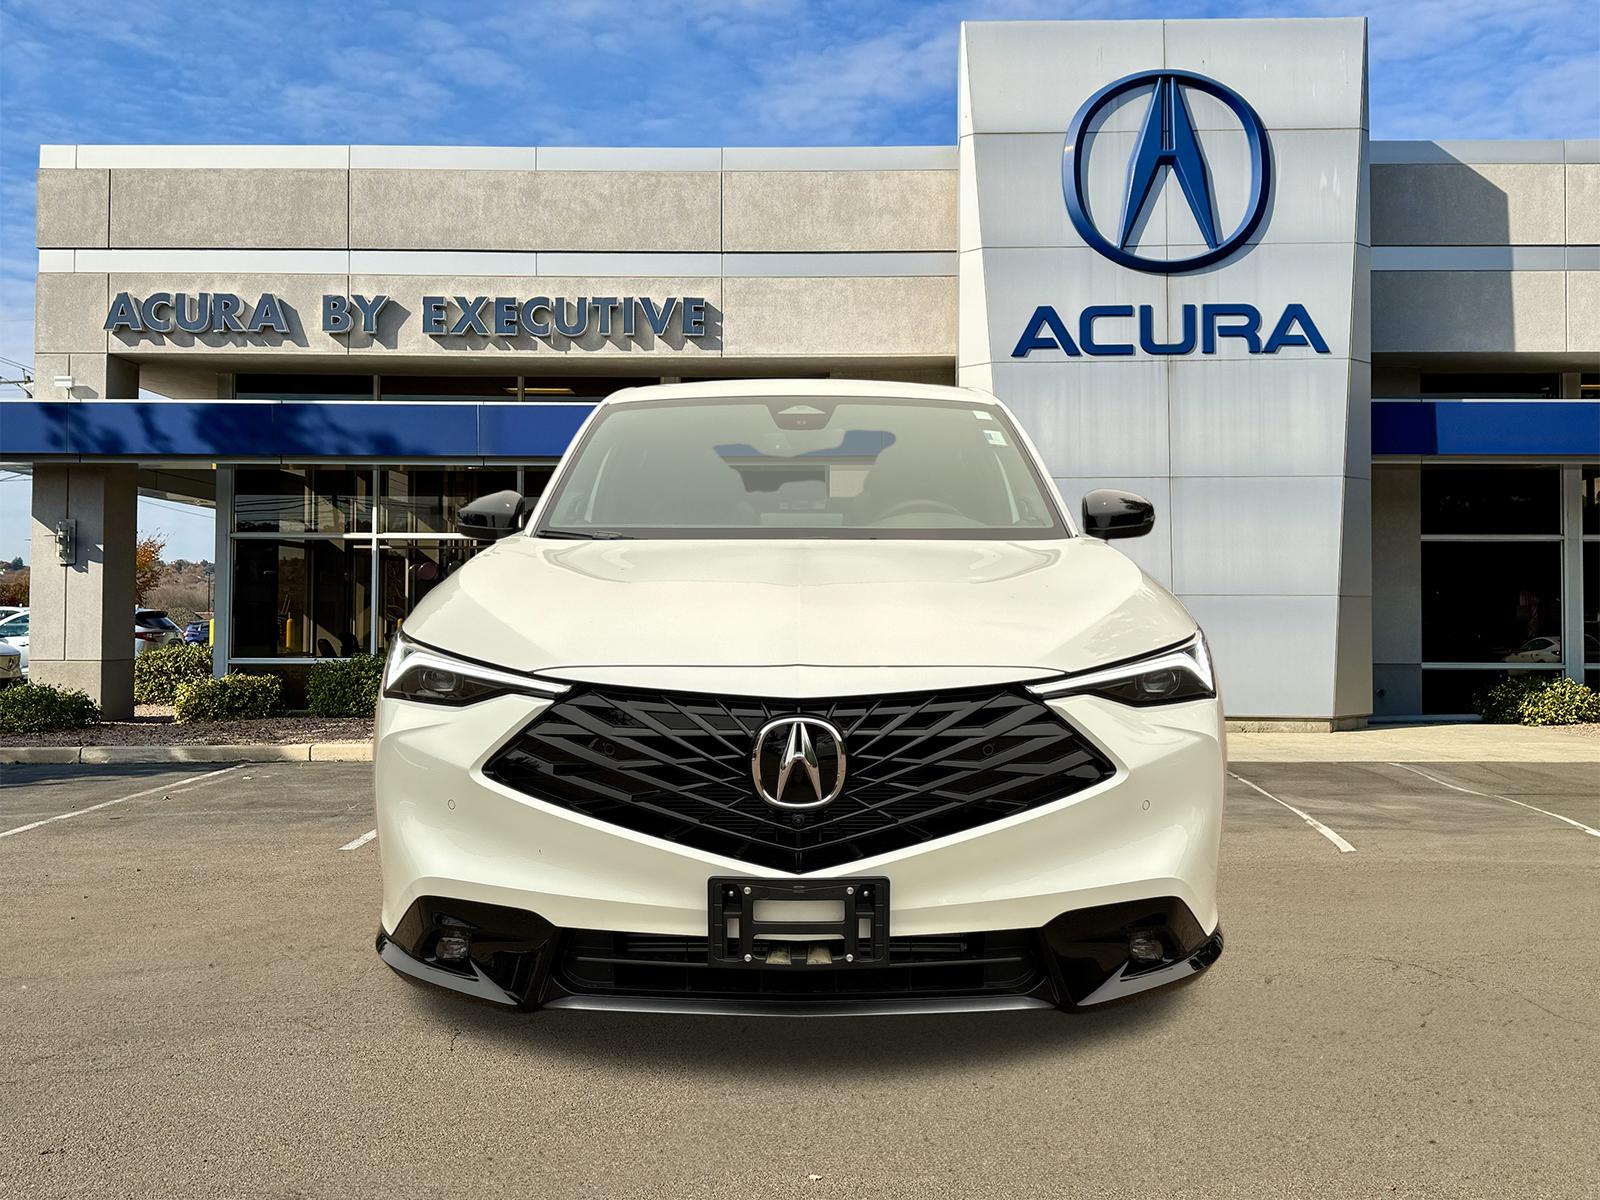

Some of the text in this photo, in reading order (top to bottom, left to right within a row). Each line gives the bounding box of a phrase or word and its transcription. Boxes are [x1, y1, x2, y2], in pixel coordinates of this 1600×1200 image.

[103, 291, 707, 337] ACURA BY EXECUTIVE
[1011, 303, 1332, 357] ACURA
